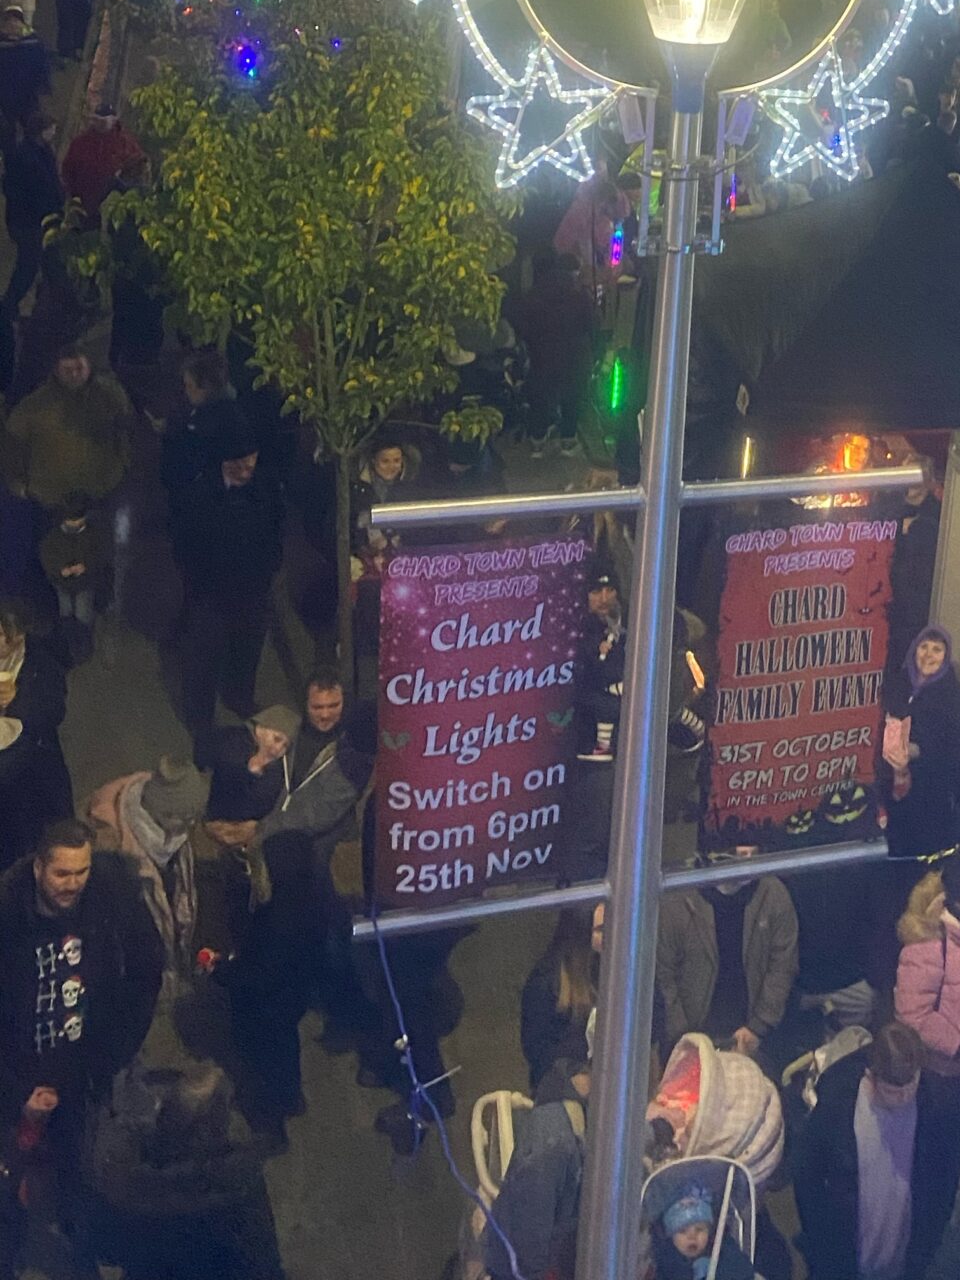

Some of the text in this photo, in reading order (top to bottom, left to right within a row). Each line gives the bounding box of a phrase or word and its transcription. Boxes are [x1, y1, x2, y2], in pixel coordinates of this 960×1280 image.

[725, 519, 898, 554] CHARD TOWN TEAM
[388, 539, 586, 579] CHARD TOWN TEAM
[763, 548, 856, 577] PRESENTS
[434, 575, 540, 606] PRESENTS
[768, 583, 846, 627] CHARD
[430, 602, 545, 652] Chard
[734, 627, 873, 678] HALLOWEEN
[386, 661, 575, 705] Christmas
[714, 671, 883, 726] FAMILY EVENT
[422, 712, 537, 765] Lights
[717, 726, 872, 765] 31ST OCTOBER
[388, 763, 567, 811] Switch on
[728, 754, 858, 791] 6PM TO 8PM
[726, 796, 741, 808] IN
[745, 793, 768, 807] THE
[773, 788, 809, 804] TOWN
[388, 803, 561, 851] from 6pm
[395, 842, 554, 894] 25th Nov
